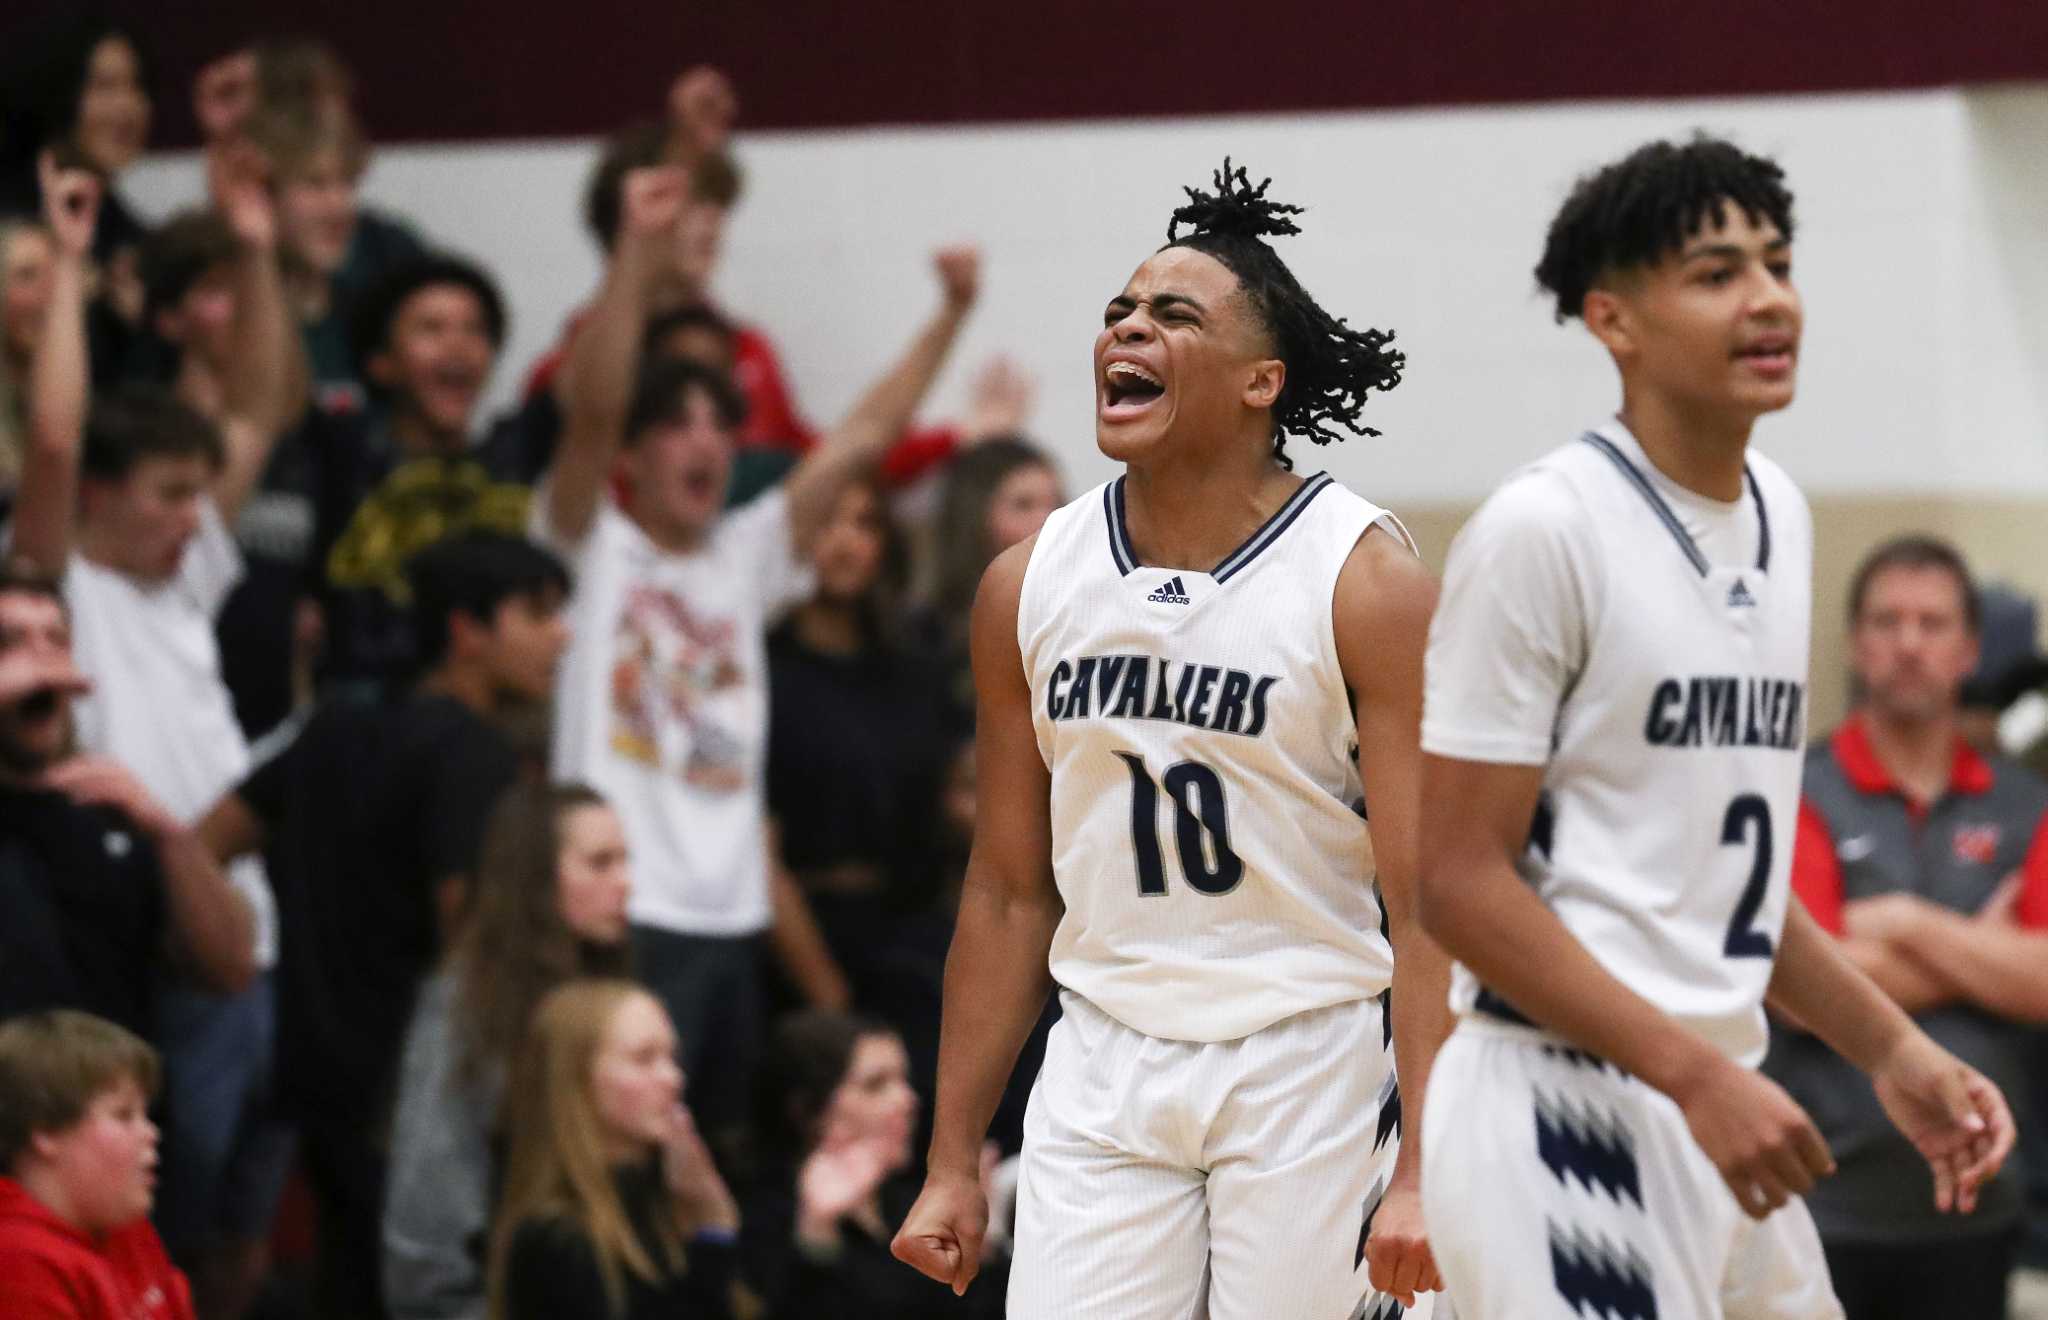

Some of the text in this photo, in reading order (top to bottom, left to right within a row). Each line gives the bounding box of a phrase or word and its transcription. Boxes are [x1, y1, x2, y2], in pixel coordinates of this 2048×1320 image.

[1147, 593, 1191, 605] adidas
[1047, 655, 1283, 737] CAVALIERS
[1112, 750, 1246, 898] 10
[1720, 793, 1773, 958] 2
